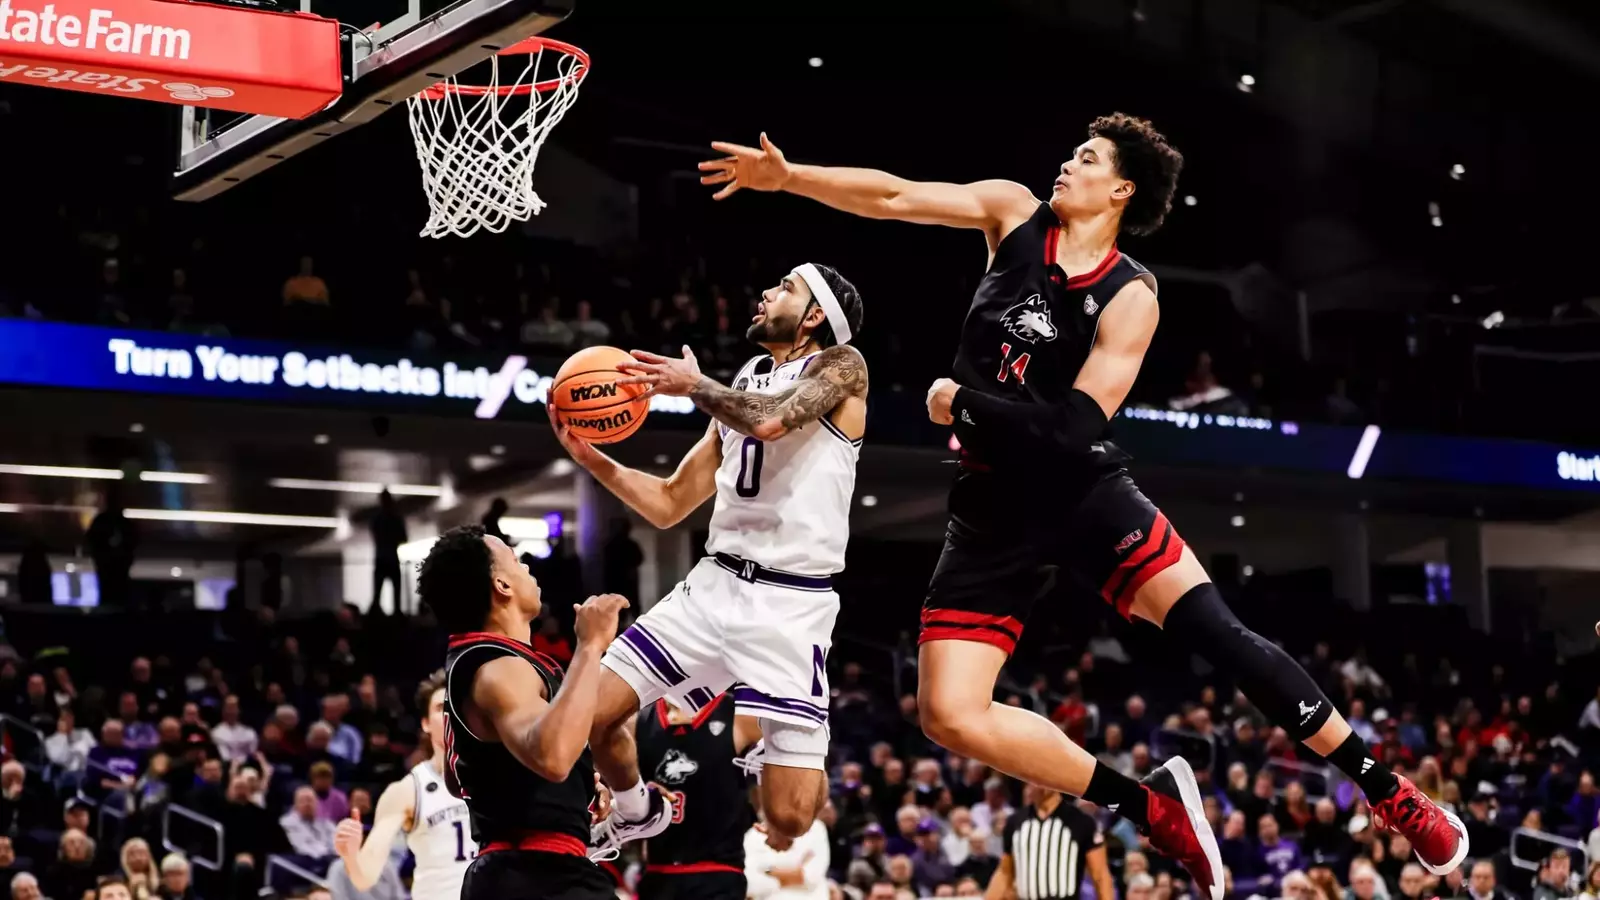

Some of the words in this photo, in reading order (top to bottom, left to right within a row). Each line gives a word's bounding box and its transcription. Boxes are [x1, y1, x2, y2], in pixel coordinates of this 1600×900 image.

[0, 0, 82, 48] tate
[85, 8, 191, 60] Farm
[23, 66, 160, 93] State
[108, 338, 193, 379] Turn
[195, 344, 279, 385] Your
[282, 351, 441, 396] Setbacks
[570, 381, 618, 403] NCAA
[567, 408, 634, 432] Wilson
[736, 436, 764, 498] 0
[1114, 529, 1143, 555] NIU
[451, 821, 479, 863] 1
